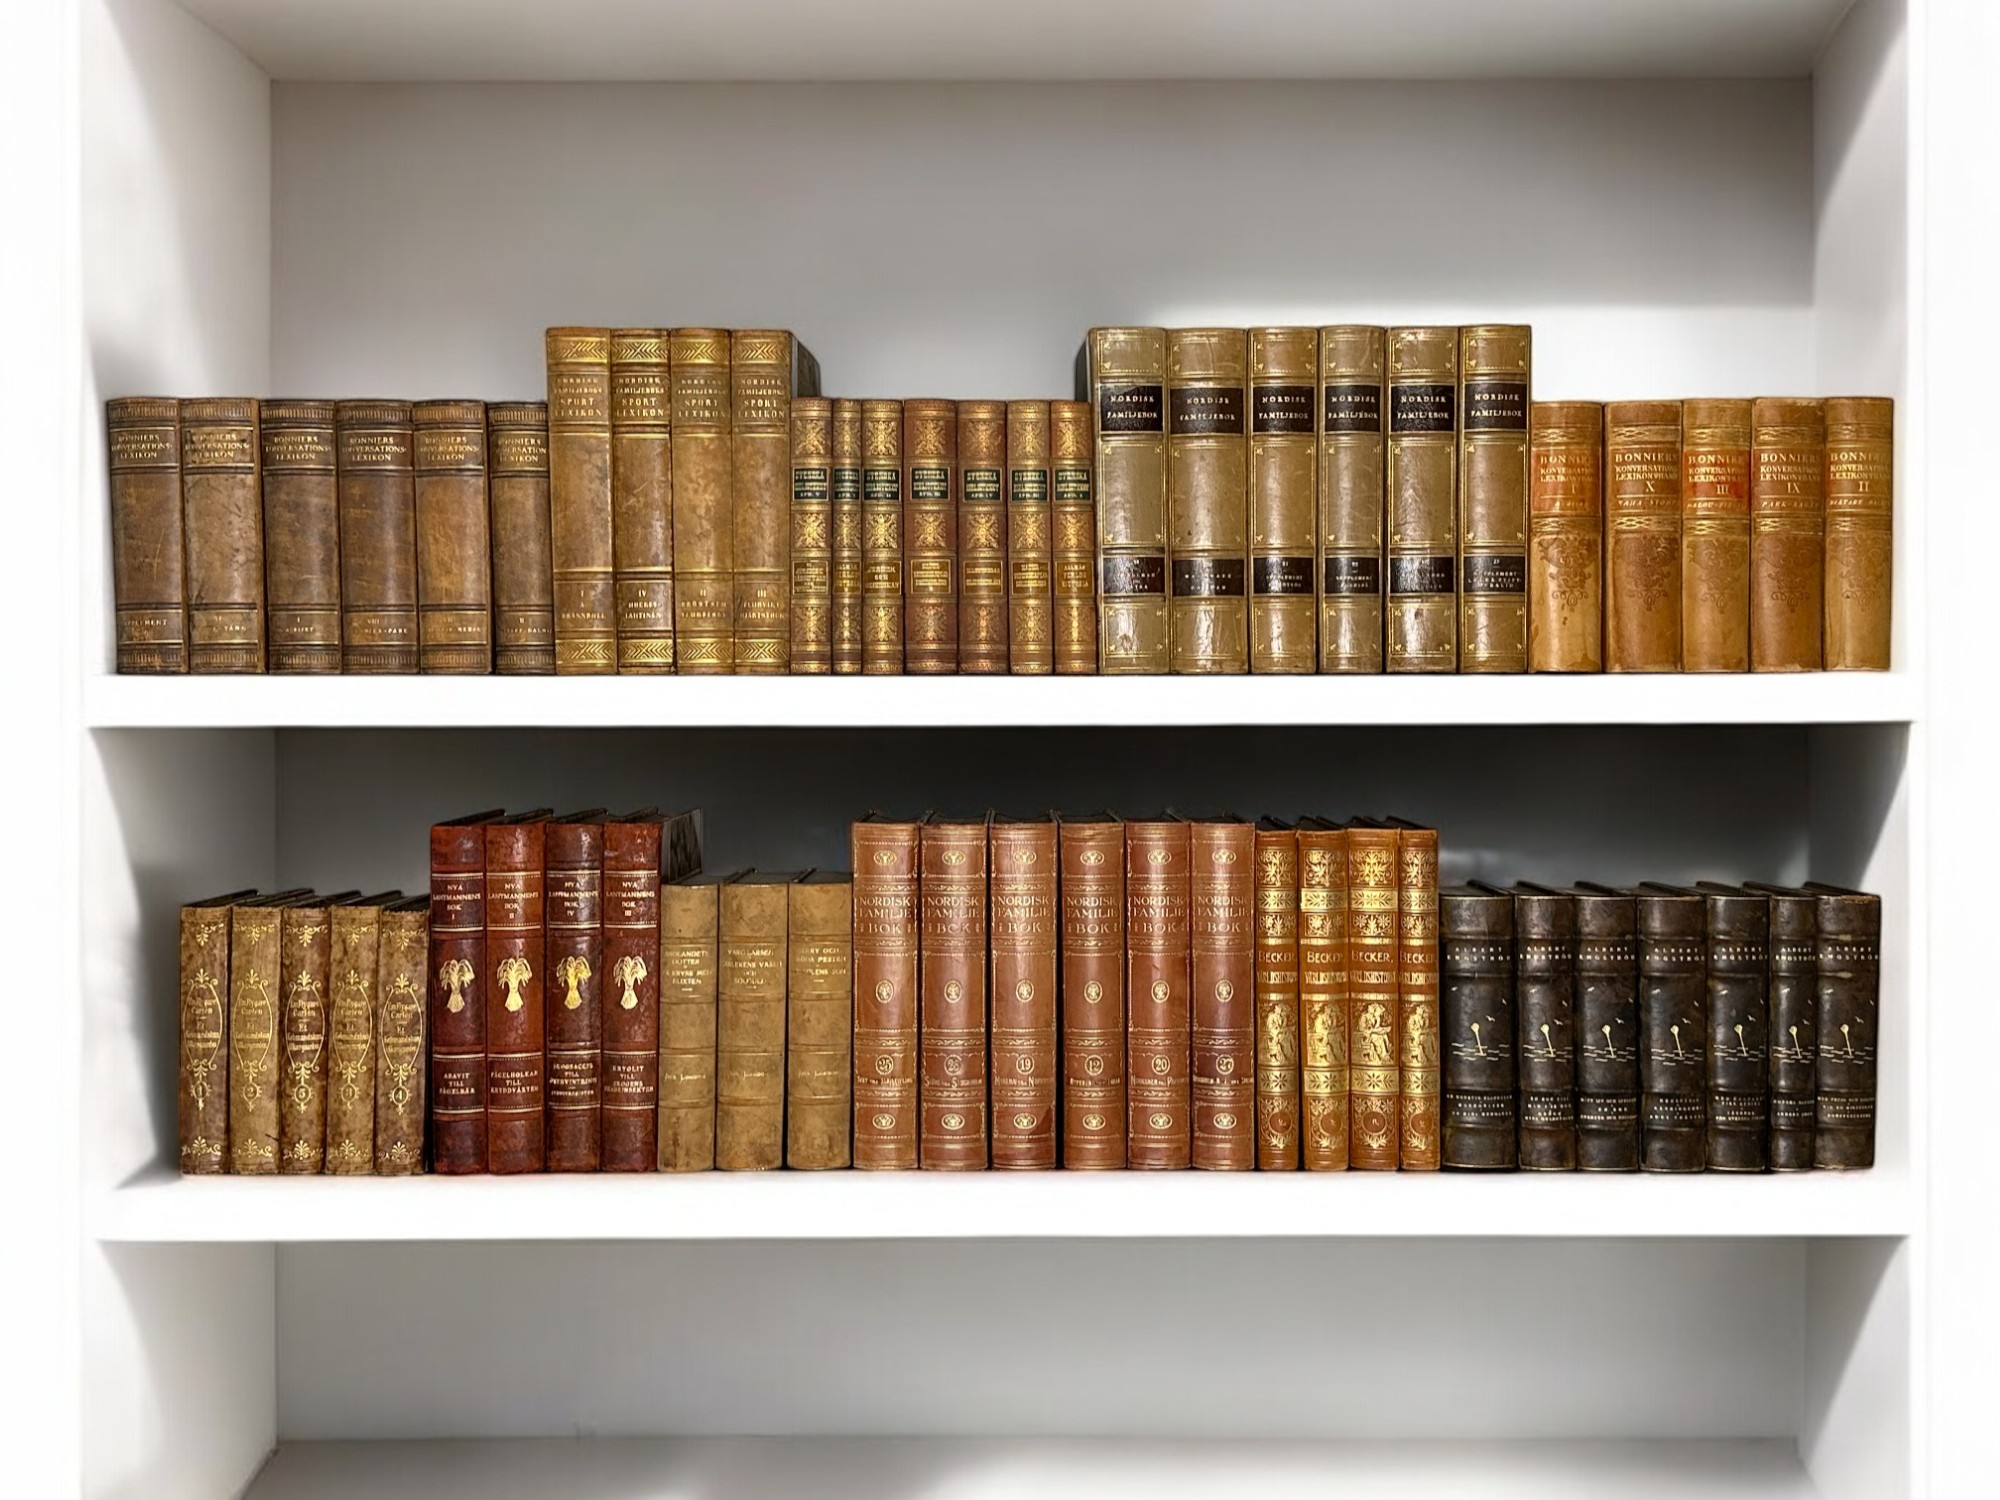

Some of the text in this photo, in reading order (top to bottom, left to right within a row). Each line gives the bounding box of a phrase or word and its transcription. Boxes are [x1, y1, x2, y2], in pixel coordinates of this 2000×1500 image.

[1110, 395, 1154, 403] NORDISK
[1186, 397, 1230, 405] NORDISK
[1261, 395, 1306, 403] NORDISK
[1331, 395, 1376, 403] NORDISK
[1400, 395, 1446, 403] NORDISK
[1474, 393, 1520, 401] NORDISK
[1106, 411, 1158, 419] FAMILJEBOK
[1328, 412, 1378, 420] FAMILJEBOK
[1397, 411, 1449, 419] FAMILJEBOK
[1470, 409, 1522, 417] FAMILJEBOK
[1615, 453, 1678, 463] BONNIERS
[1616, 472, 1654, 480] LEXIKON
[1760, 473, 1798, 481] LEXIKON
[1645, 481, 1655, 492] X
[1787, 483, 1800, 493] IX
[1858, 481, 1869, 492] II
[638, 590, 647, 598] IV
[757, 589, 767, 598] III
[859, 896, 911, 907] NORDISK
[927, 896, 979, 907] NORDISK
[998, 895, 1049, 906] NORDISK
[1067, 896, 1116, 907] NORDISK
[1133, 896, 1185, 906] NORDISK
[1199, 895, 1248, 906] NORDISK
[868, 923, 902, 934] BOK
[937, 923, 970, 934] BOK
[1008, 923, 1042, 933] BOK
[1076, 923, 1110, 934] BOK
[1143, 923, 1177, 933] BOK
[1207, 922, 1241, 933] BOK
[1019, 1059, 1031, 1071] 19
[1088, 1060, 1100, 1071] 12
[1155, 1059, 1168, 1070] 20
[396, 1089, 404, 1100] 4
